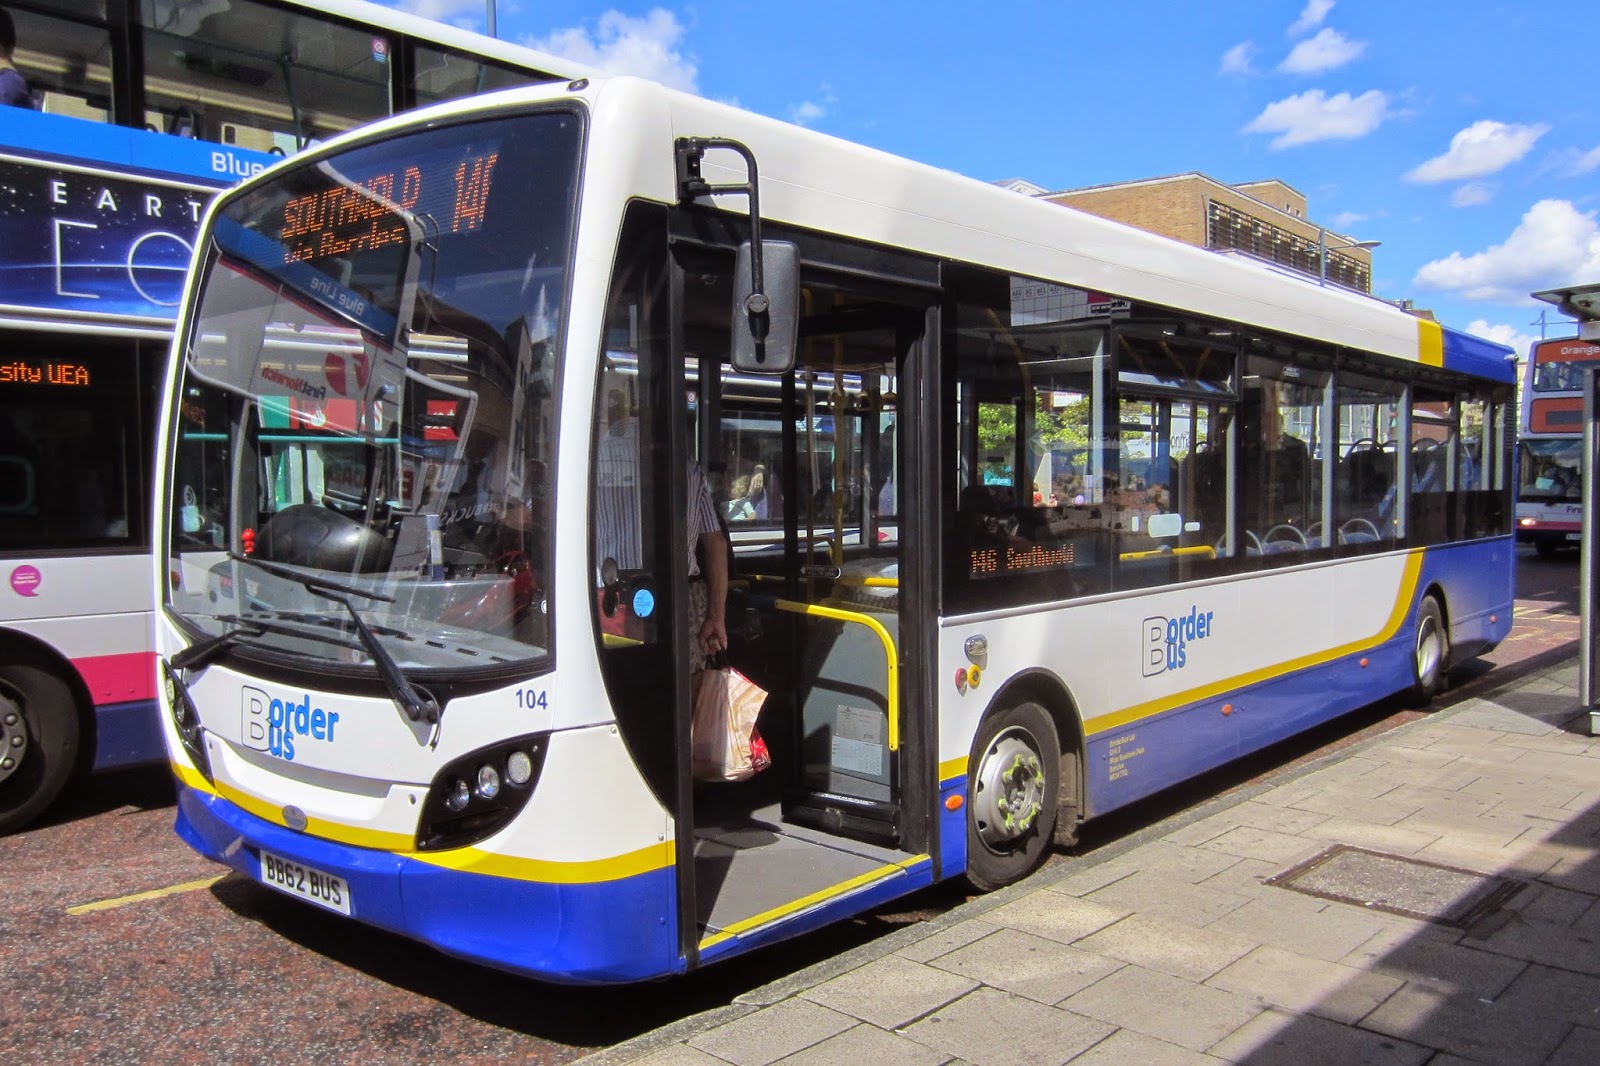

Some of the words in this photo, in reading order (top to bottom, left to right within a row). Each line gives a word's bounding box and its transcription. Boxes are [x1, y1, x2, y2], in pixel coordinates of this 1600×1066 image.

[211, 152, 265, 177] Blue
[1560, 346, 1600, 356] Orange
[0, 362, 41, 383] sity
[48, 364, 89, 385] UEA
[515, 689, 548, 710] 104
[266, 854, 305, 892] BB62
[309, 871, 342, 906] BUS
